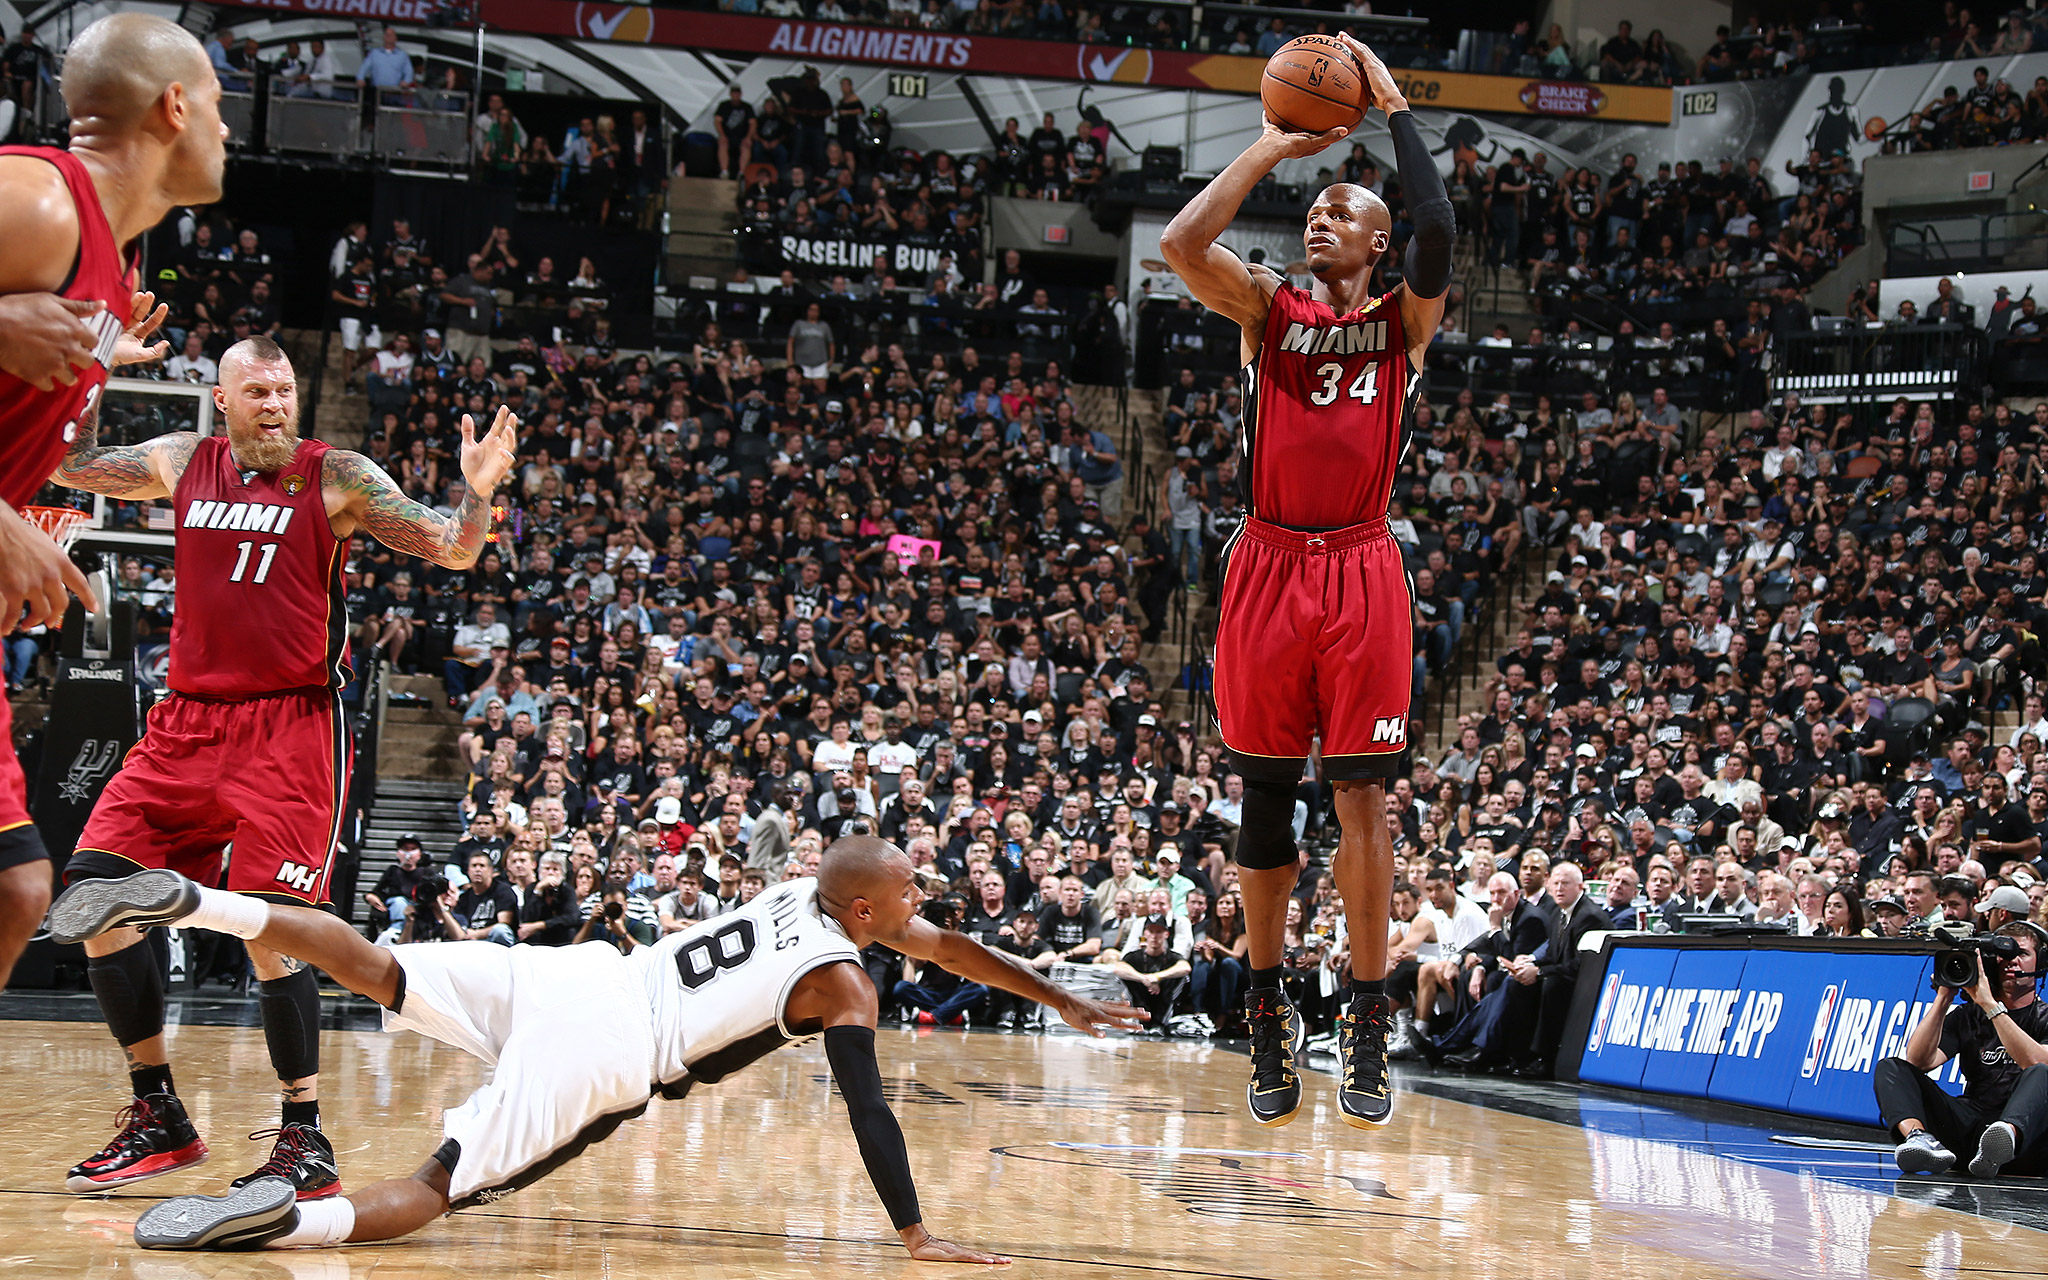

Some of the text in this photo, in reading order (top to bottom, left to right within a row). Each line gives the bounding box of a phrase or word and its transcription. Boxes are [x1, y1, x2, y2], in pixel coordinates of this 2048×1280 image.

[769, 22, 972, 67] ALIGNMENTS
[891, 75, 926, 96] 101
[1538, 97, 1587, 112] CHECK
[1539, 85, 1589, 100] BRAKE
[1685, 93, 1716, 113] 102
[1280, 320, 1388, 355] MIAMI
[1310, 361, 1379, 406] 34
[183, 499, 295, 535] MIAMI
[229, 540, 278, 584] 11
[68, 667, 123, 682] SPALDING
[764, 887, 800, 951] MILLS
[673, 917, 757, 990] 8
[1606, 984, 1784, 1060] NBA GAME TIME APP
[1825, 998, 1885, 1074] NBA
